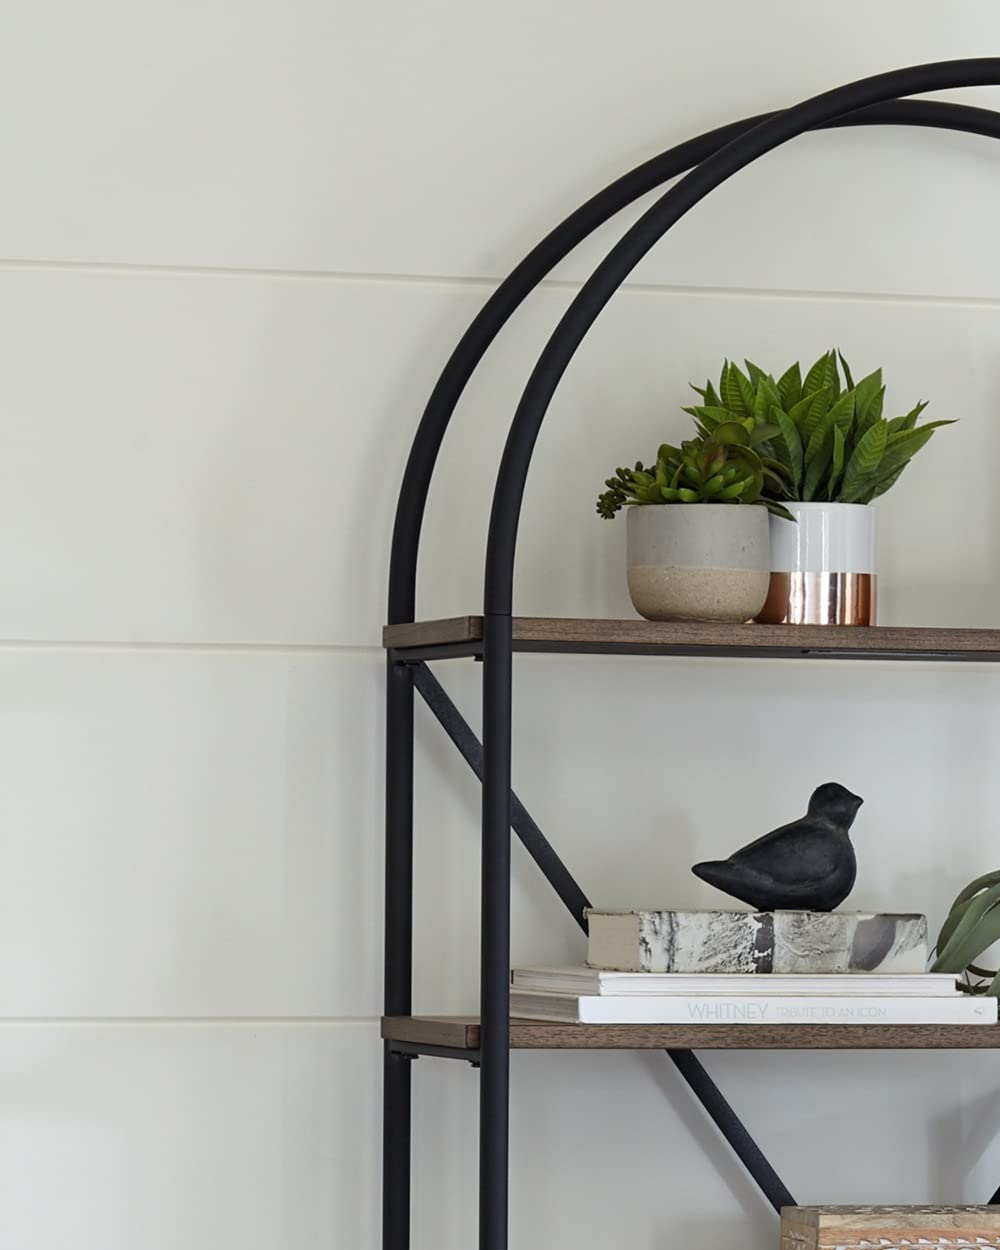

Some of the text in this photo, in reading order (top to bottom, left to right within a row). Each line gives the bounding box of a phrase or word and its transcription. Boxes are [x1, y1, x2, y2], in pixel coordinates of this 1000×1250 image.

[687, 1002, 887, 1019] WHITNEY TRIBUTE TO AN ICON
